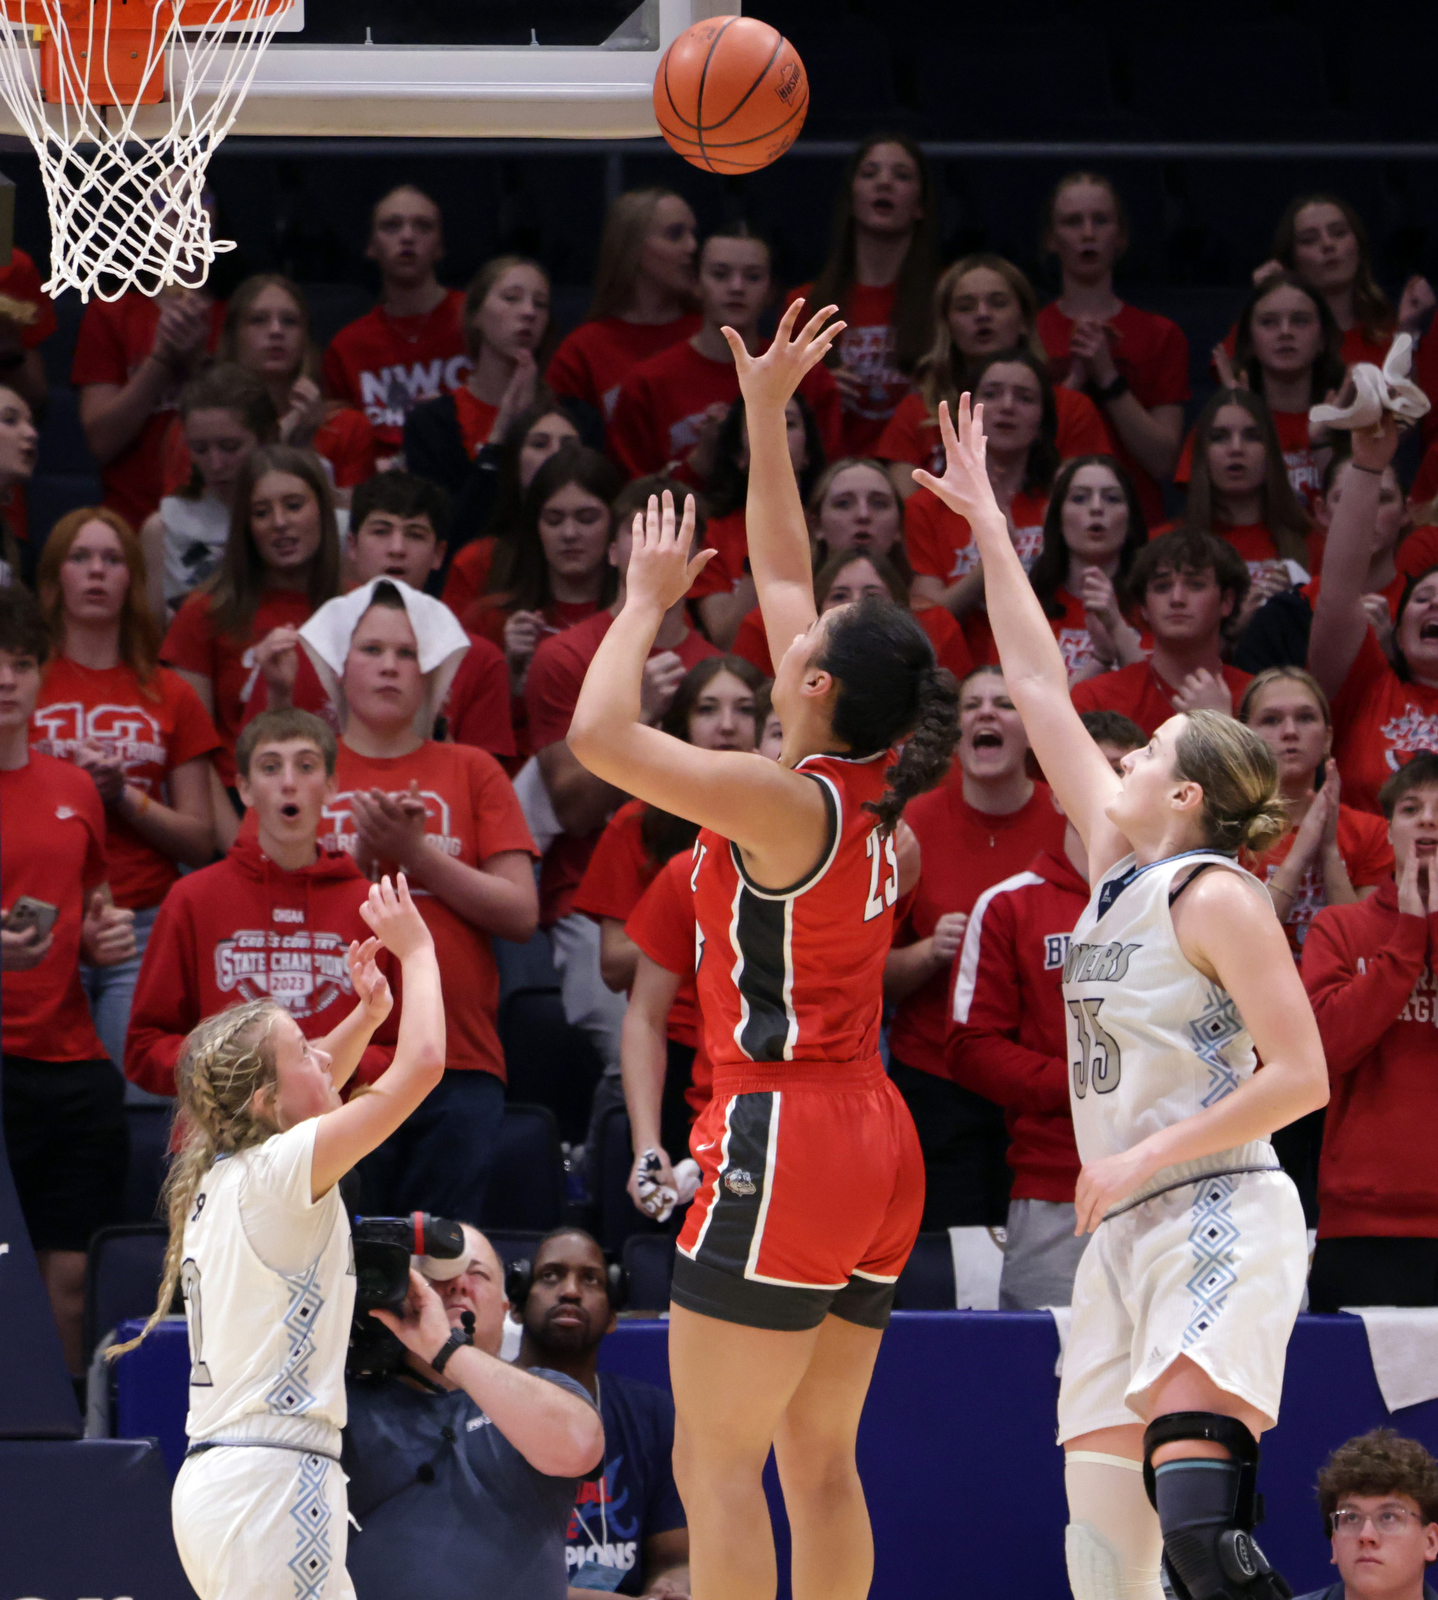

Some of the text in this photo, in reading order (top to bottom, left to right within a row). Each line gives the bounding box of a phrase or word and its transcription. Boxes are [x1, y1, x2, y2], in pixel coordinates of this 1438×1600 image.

[863, 823, 898, 922] 23
[238, 936, 336, 951] CROS COUTRY
[1063, 941, 1144, 984] OVERS
[222, 949, 266, 985] STATE
[273, 977, 305, 991] 2023
[1067, 998, 1121, 1099] 35
